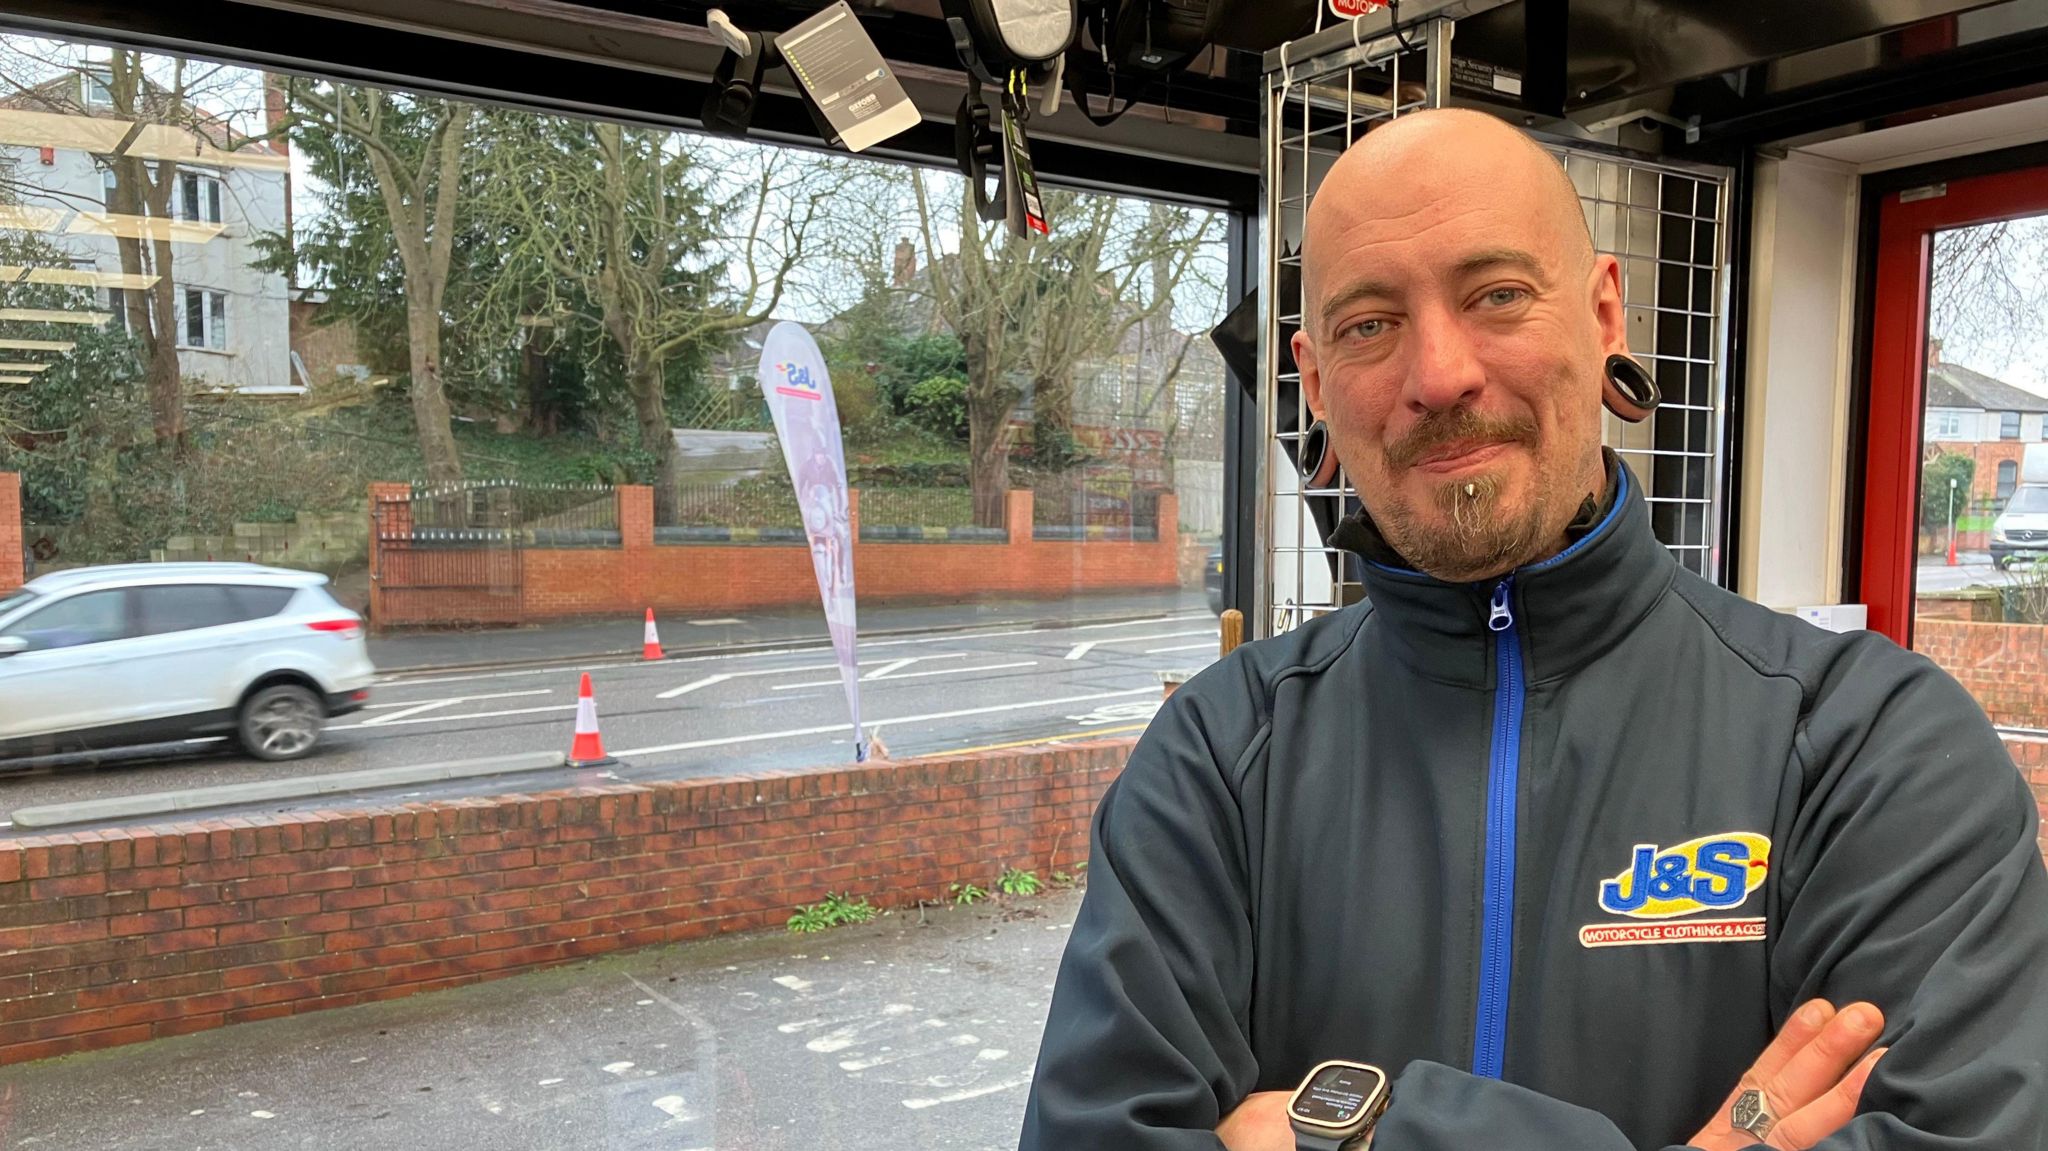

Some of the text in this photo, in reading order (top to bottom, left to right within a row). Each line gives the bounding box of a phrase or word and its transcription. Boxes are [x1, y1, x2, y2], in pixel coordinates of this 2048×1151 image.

[849, 93, 877, 112] OXFORD
[1602, 841, 1750, 912] J&S
[1584, 927, 1661, 943] MOTORCYCLE
[1663, 924, 1723, 938] CLOTHING
